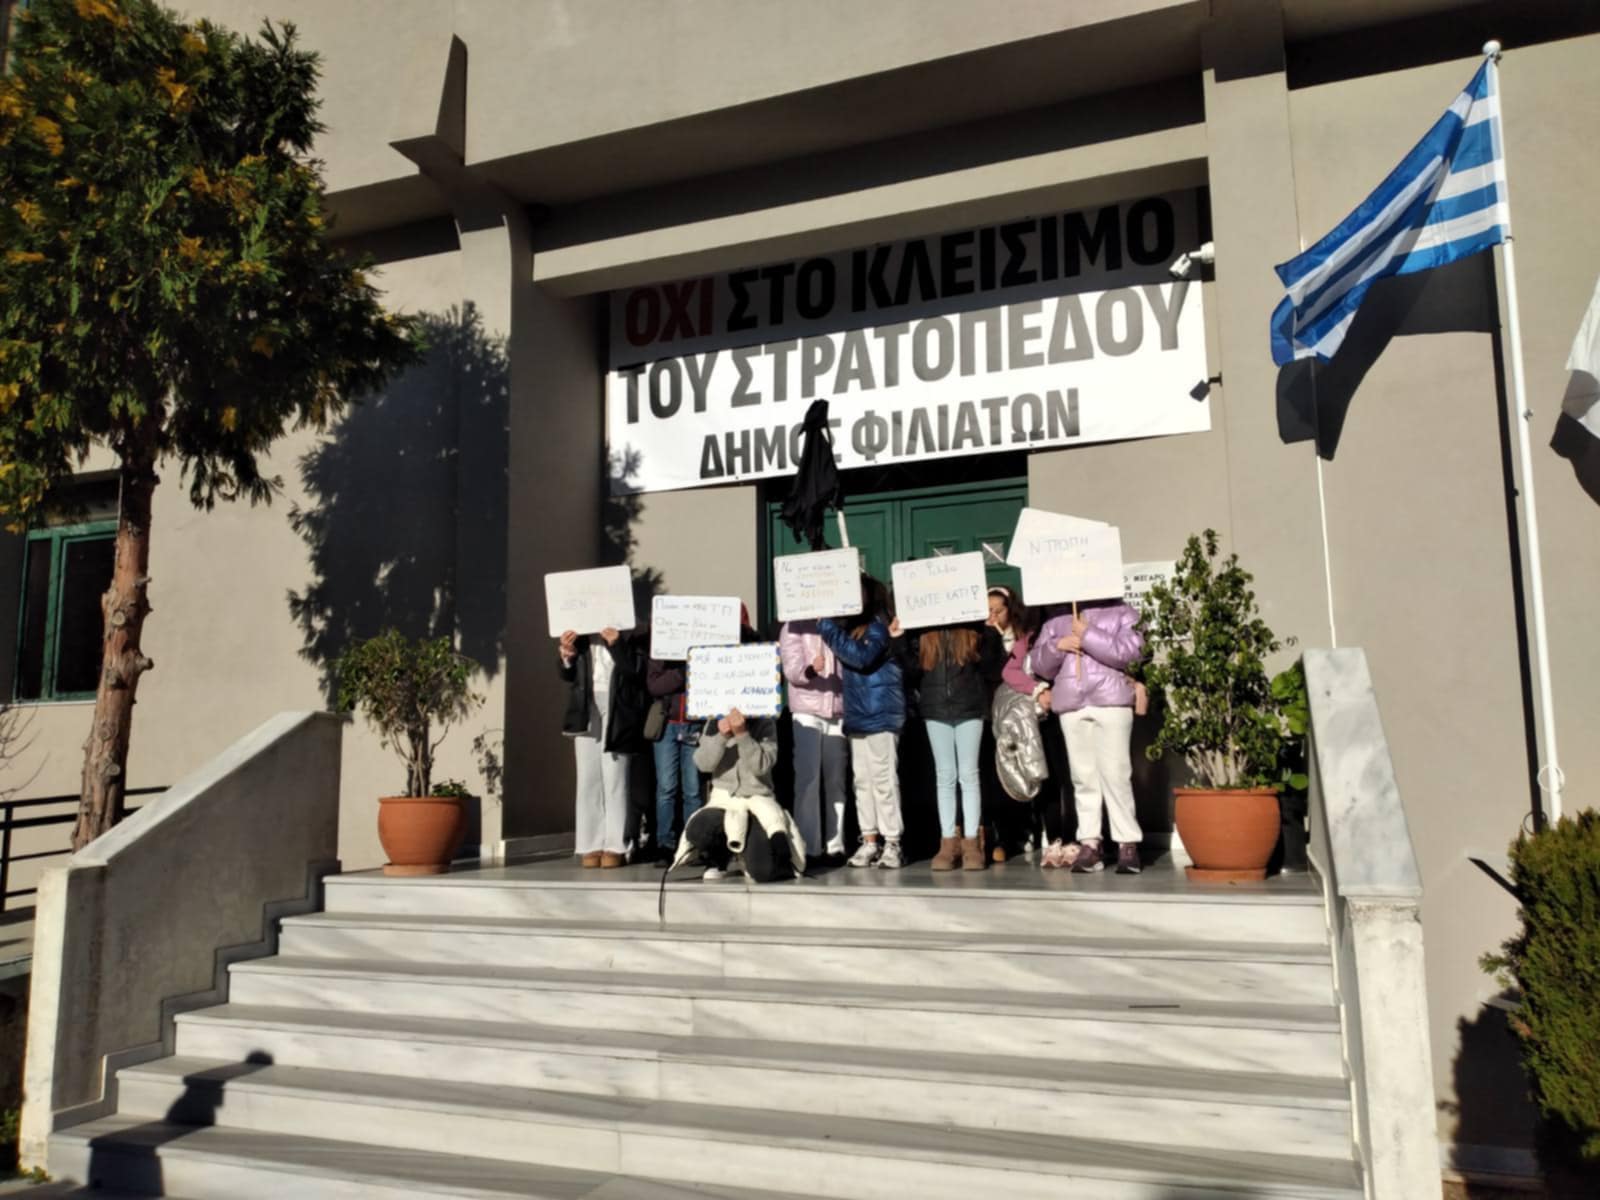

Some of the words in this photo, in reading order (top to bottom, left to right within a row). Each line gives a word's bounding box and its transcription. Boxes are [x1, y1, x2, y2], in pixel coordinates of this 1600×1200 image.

[624, 276, 715, 347] ΟΧΙ
[726, 258, 837, 332] ΣΤΟ
[851, 197, 1176, 312] ΚΛΕΙΣΙΜΟ
[618, 348, 716, 425] ΤΟΥ
[730, 282, 1193, 408] ΣΤΡΑΤΟΠΕΔΟΥ
[851, 387, 1081, 460] ΦΙΛΙΑΤΩΝ
